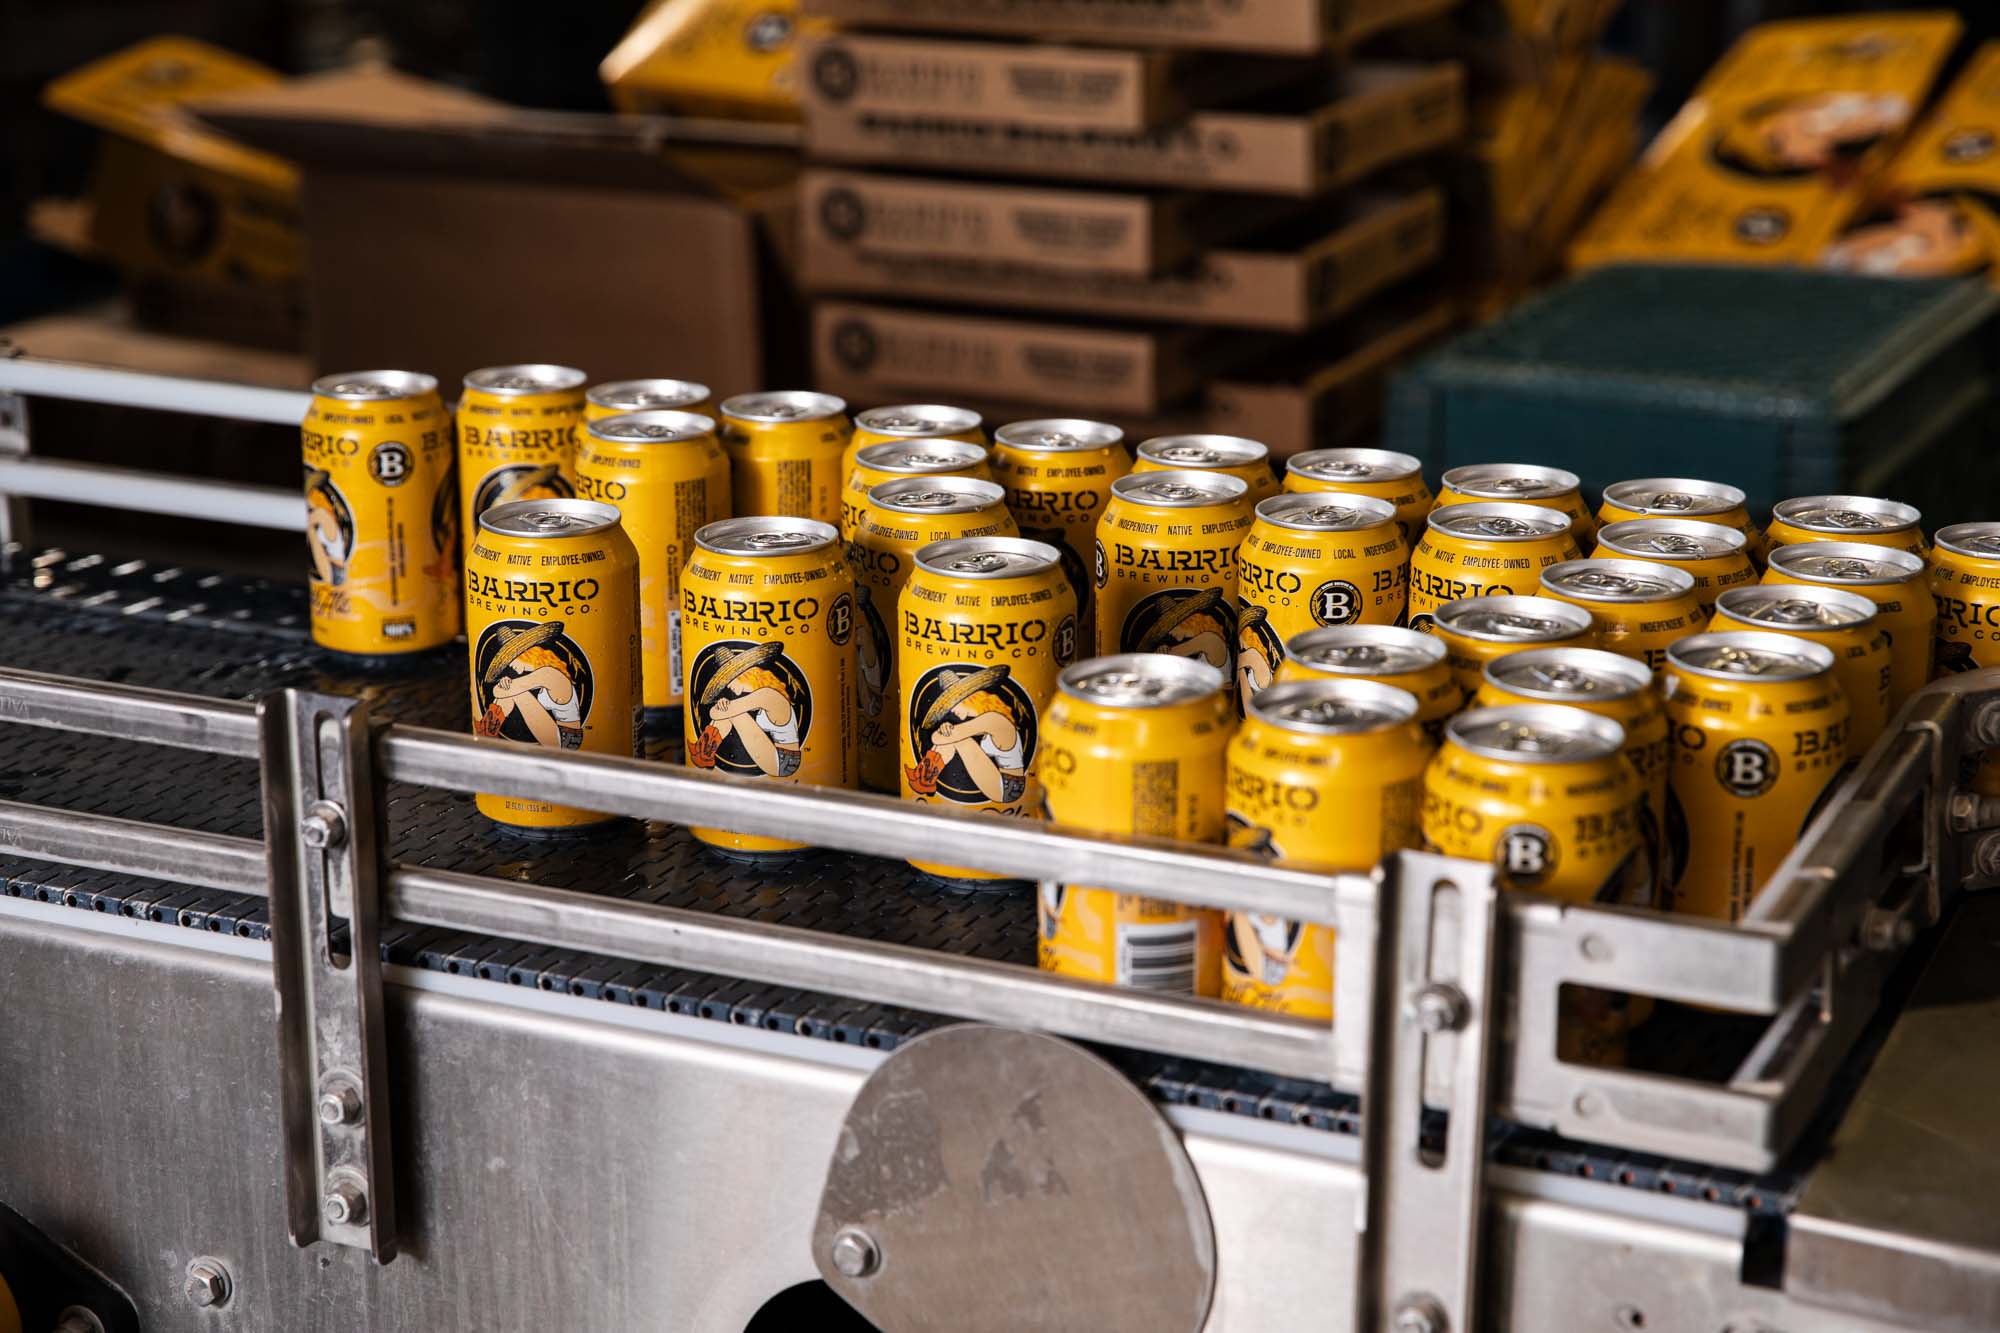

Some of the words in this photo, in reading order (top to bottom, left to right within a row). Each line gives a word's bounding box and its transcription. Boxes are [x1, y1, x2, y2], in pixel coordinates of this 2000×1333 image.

[380, 450, 405, 478] B
[867, 523, 919, 541] EMPLOYEE-OWNED
[1117, 518, 1160, 535] INDEPENDENT
[1167, 524, 1193, 536] NATIVE
[507, 554, 532, 566] NATIVE
[541, 550, 606, 567] EMPLOYEE-OWNED
[1261, 541, 1322, 560] EMPLOYEE-OWNED
[1332, 548, 1357, 560] LOCAL
[1435, 549, 1456, 564] NATIVE
[1462, 555, 1531, 569] EMPLOYEE-OWNED
[728, 573, 755, 585] NATIVE
[763, 567, 828, 585] EMPLOYEE-OWNED
[1117, 568, 1211, 584] BREWING
[1223, 567, 1239, 581] C
[468, 568, 600, 609] BARRIO
[954, 595, 981, 608] NATIVE
[990, 588, 1053, 607] EMPLOYEE-OWNED
[469, 594, 549, 617] BREWING
[564, 604, 599, 617] CO.
[683, 588, 819, 628] BARRIO
[1268, 594, 1299, 608] CO.
[1323, 592, 1350, 619] B
[685, 615, 768, 638] BREWING
[784, 623, 818, 636] CO.
[905, 611, 1047, 650] BARRIO
[906, 637, 995, 660] BREWING
[1731, 751, 1766, 786] B
[1507, 833, 1546, 875] B
